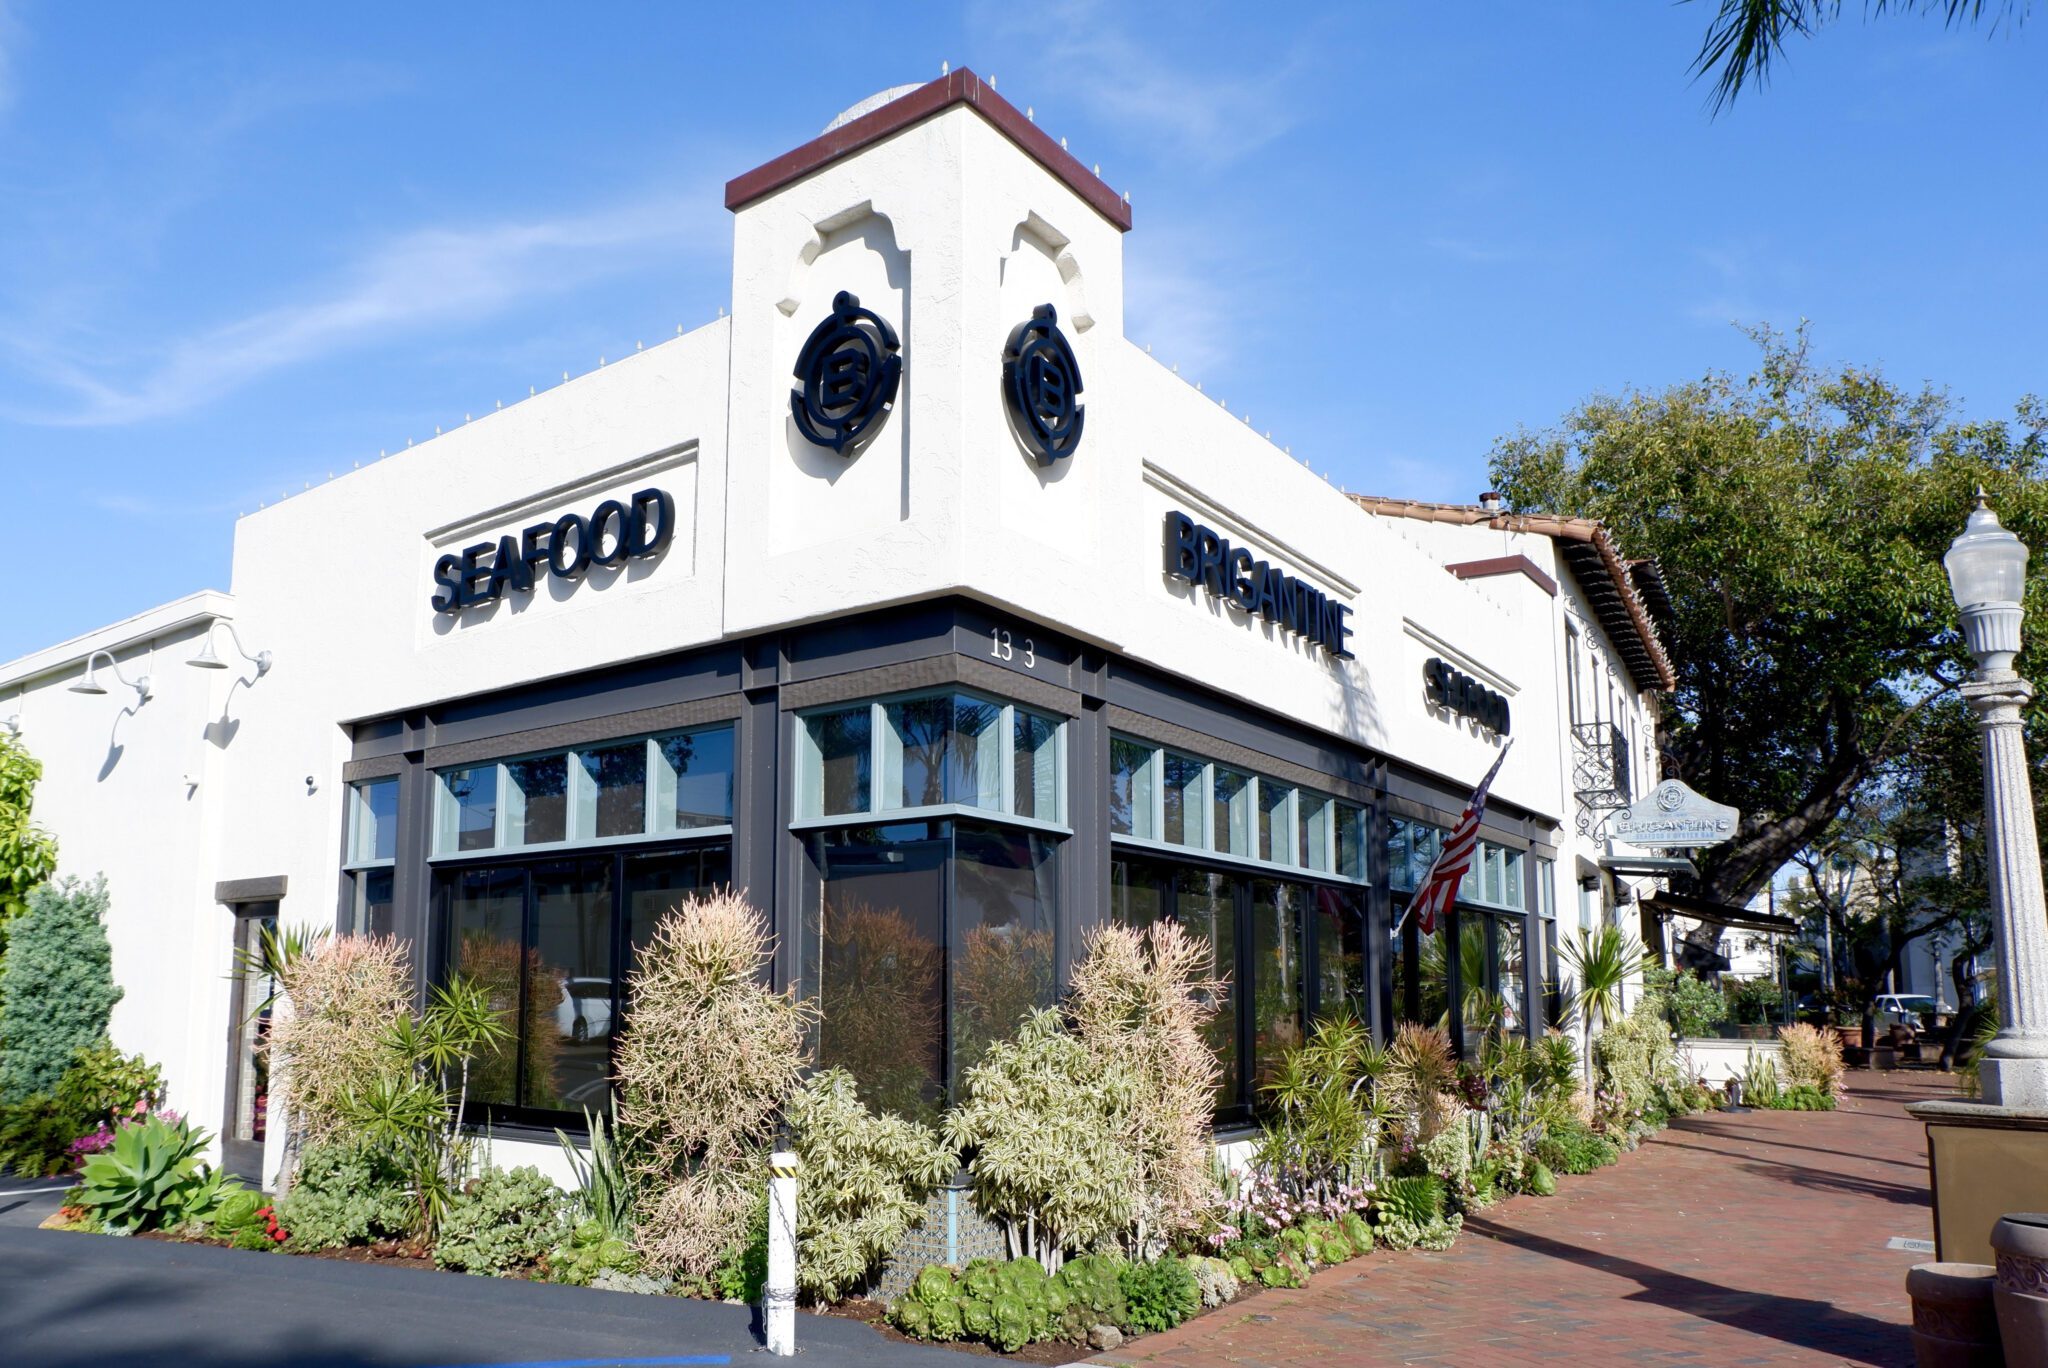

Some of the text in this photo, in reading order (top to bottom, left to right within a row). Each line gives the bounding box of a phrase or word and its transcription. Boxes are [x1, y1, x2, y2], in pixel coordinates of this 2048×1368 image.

[431, 487, 676, 614] SEAFOOD
[1165, 510, 1356, 662] BRIGANTINE
[1617, 818, 1729, 834] BRIGANTINE
